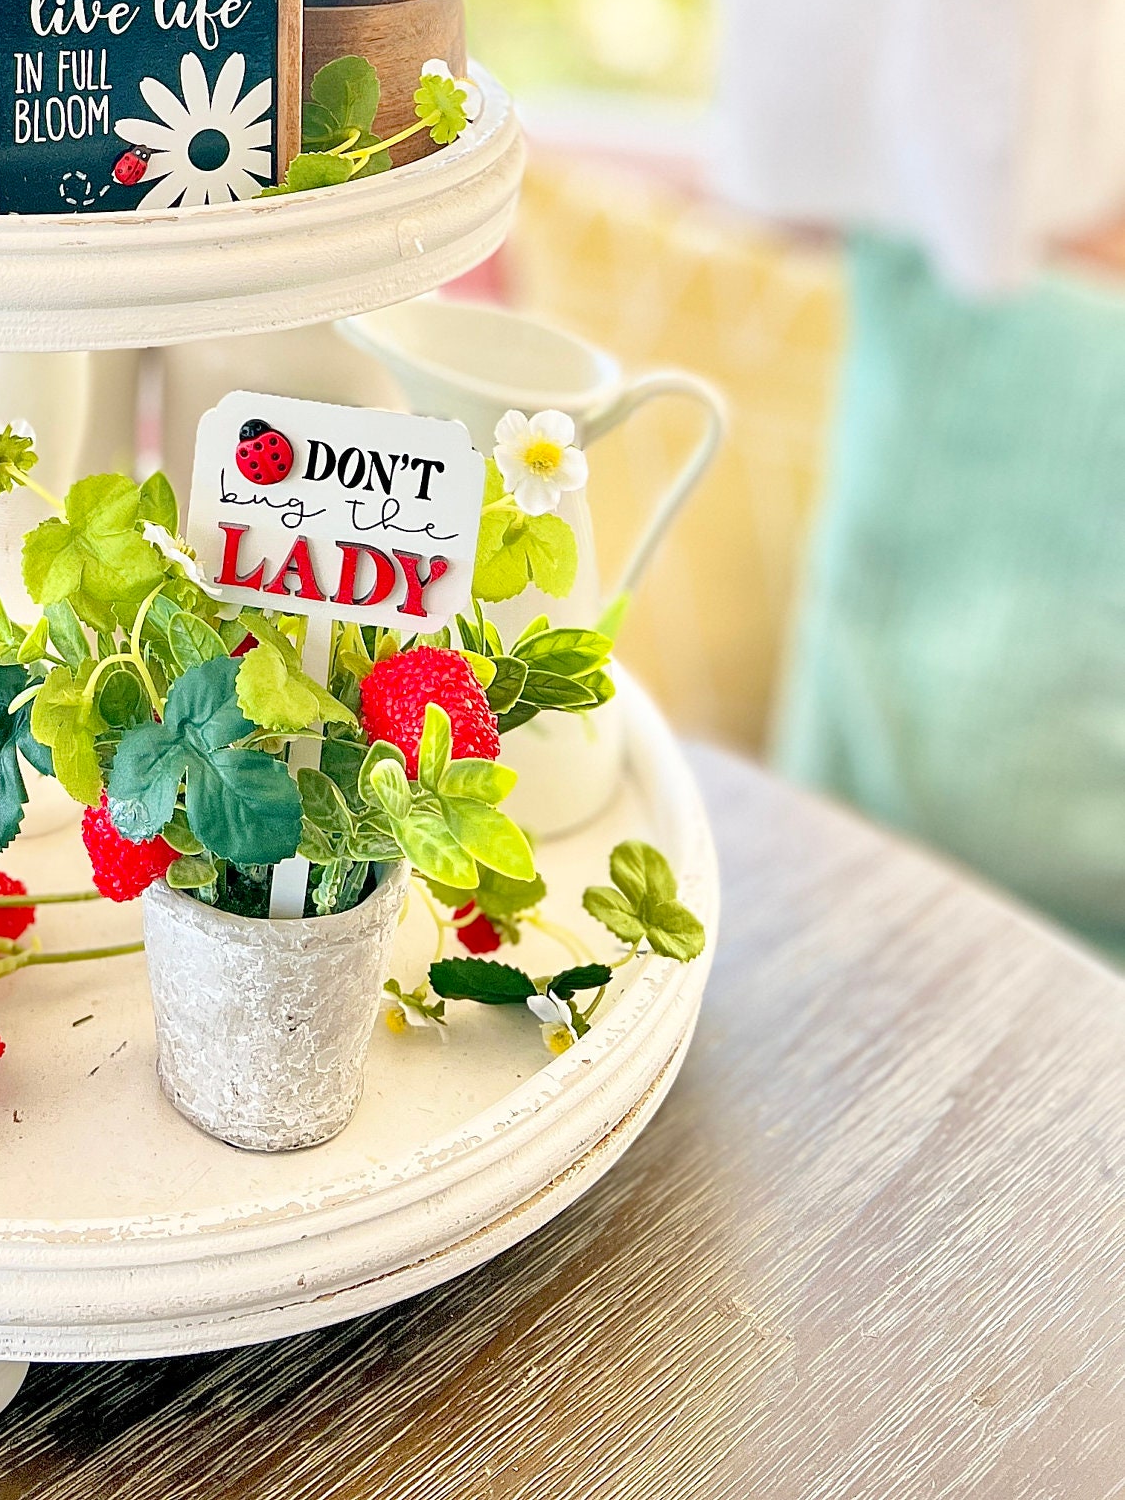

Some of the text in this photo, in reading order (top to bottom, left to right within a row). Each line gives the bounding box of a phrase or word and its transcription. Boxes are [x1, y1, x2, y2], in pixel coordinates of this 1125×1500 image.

[13, 49, 112, 94] IN FULL
[14, 95, 109, 144] BLOOM
[301, 439, 445, 501] DON'T
[219, 467, 459, 540] bug the
[214, 521, 449, 618] LADY
